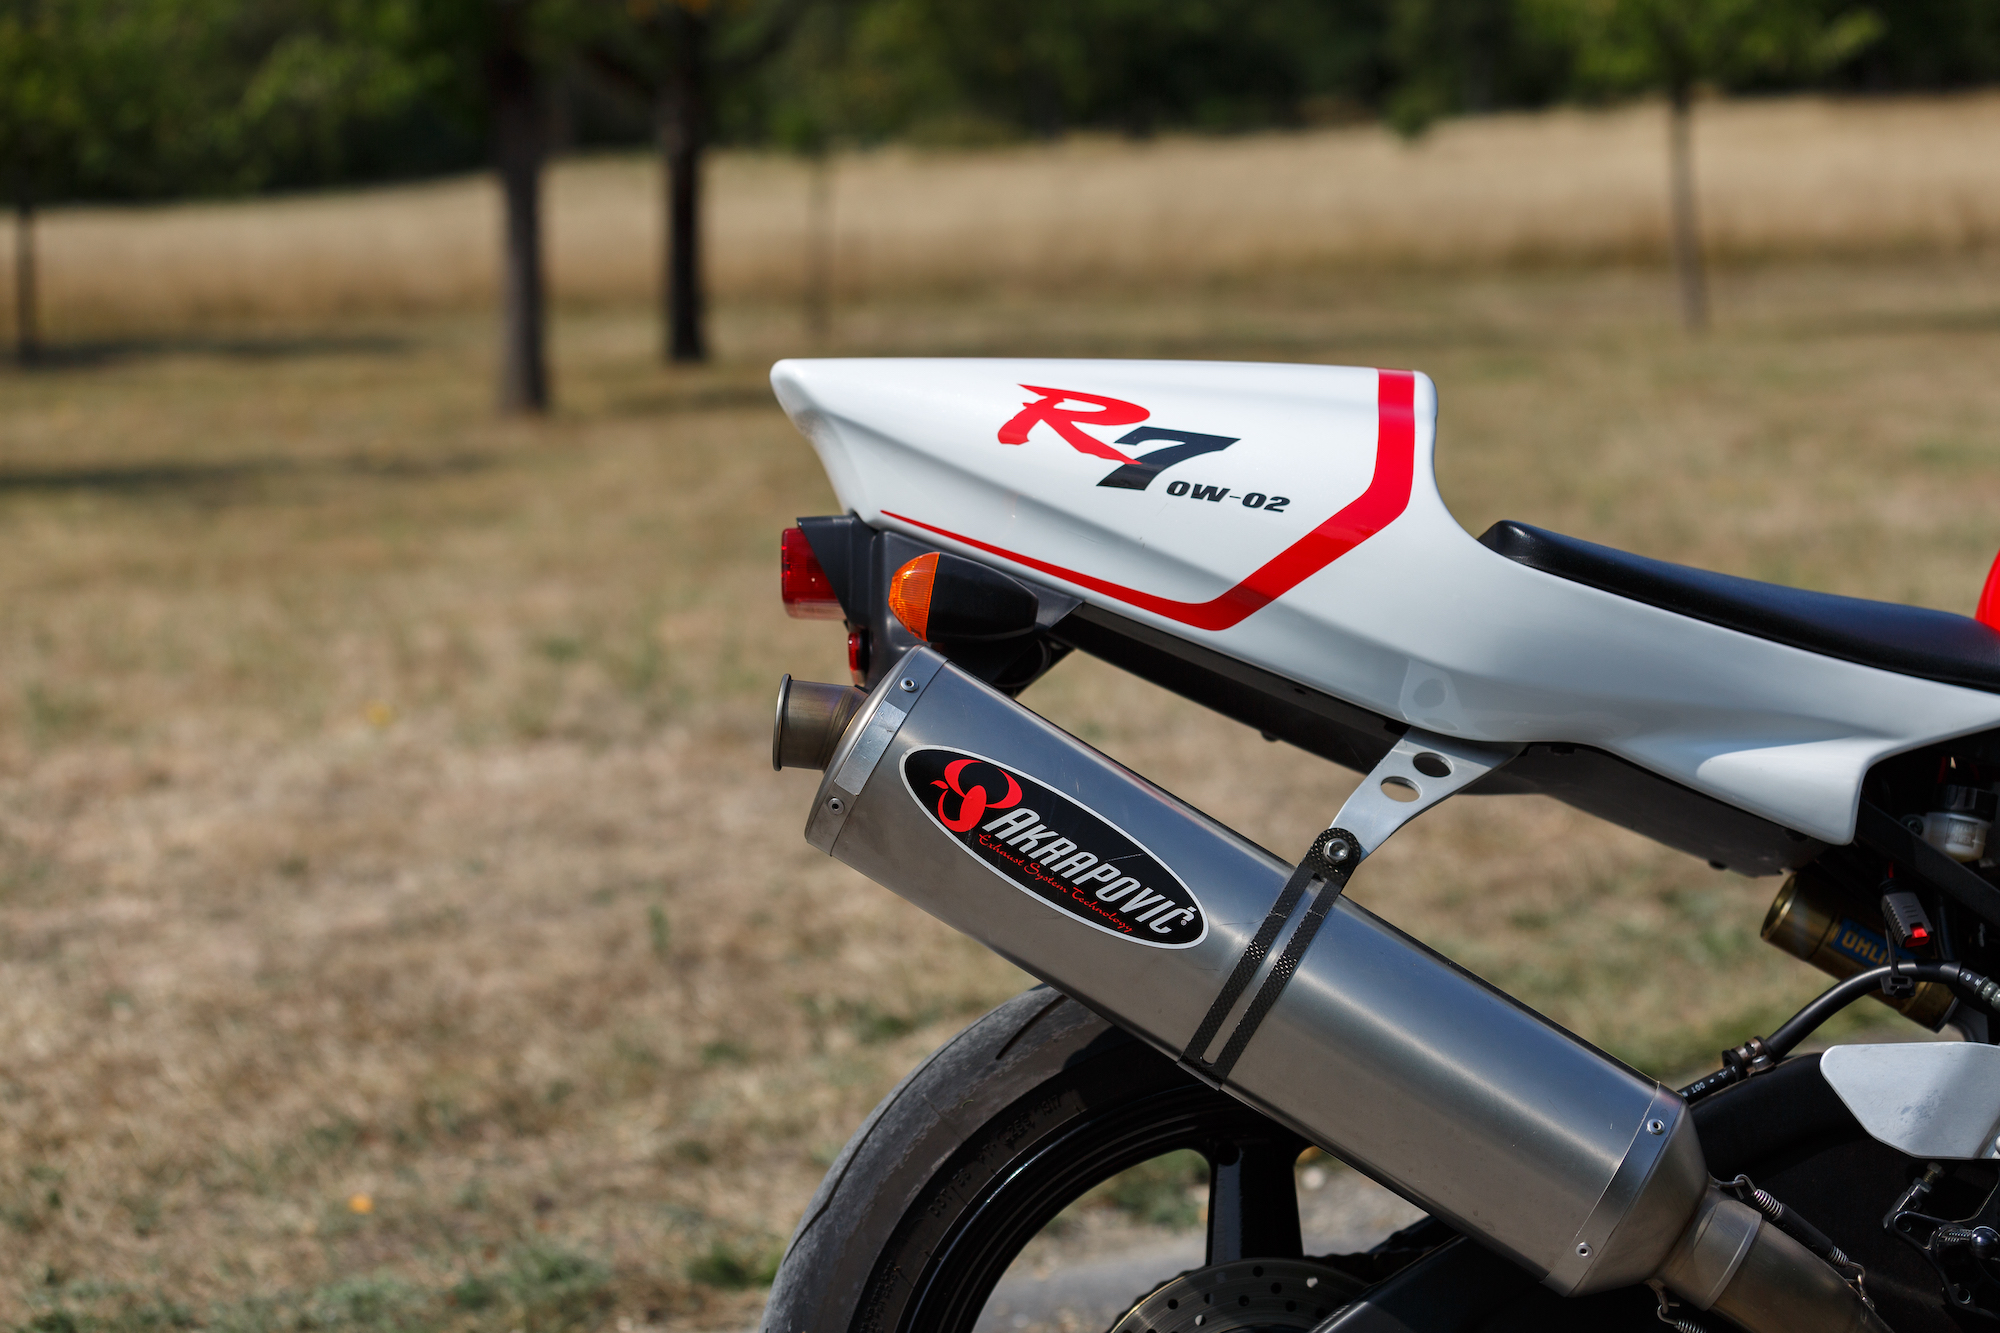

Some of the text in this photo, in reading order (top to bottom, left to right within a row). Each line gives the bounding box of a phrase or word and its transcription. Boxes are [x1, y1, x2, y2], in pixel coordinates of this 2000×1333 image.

[998, 384, 1241, 491] R7
[978, 833, 1133, 933] Exhaust System Technology
